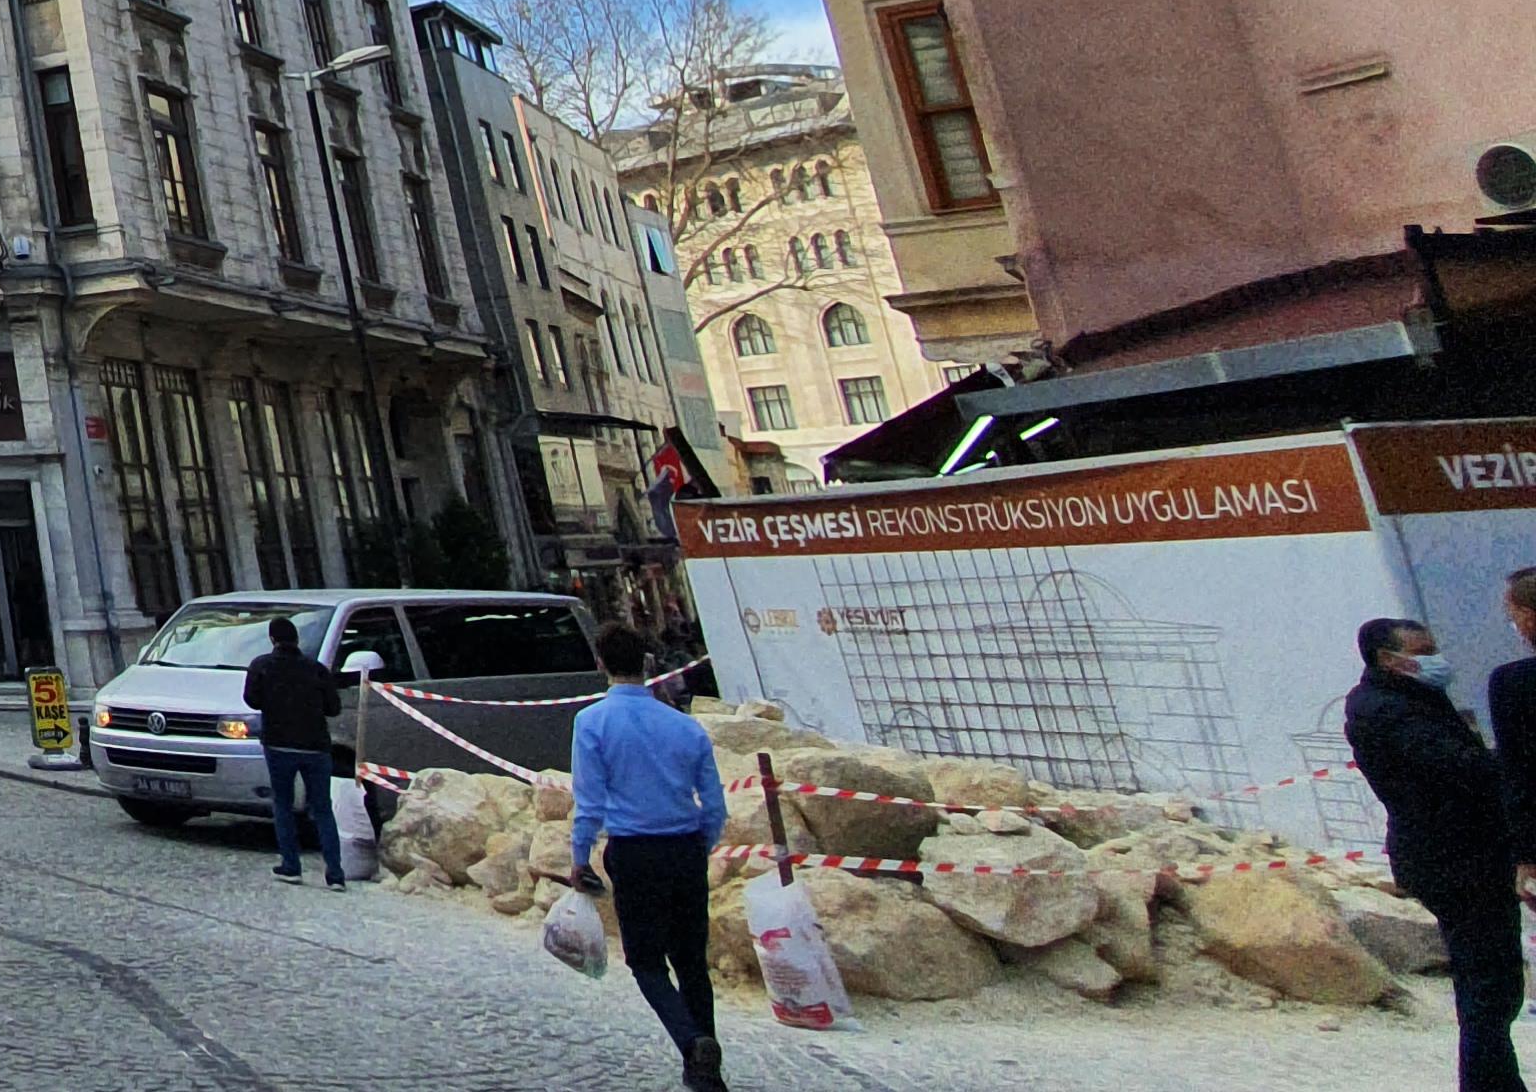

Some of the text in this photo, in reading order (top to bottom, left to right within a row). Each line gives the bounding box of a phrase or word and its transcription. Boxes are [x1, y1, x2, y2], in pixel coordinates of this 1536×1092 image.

[697, 479, 1318, 547] VEZİR ÇEŞMESİ REKONSTRÜKSİYON UYGULAMASI
[34, 680, 57, 704] 5
